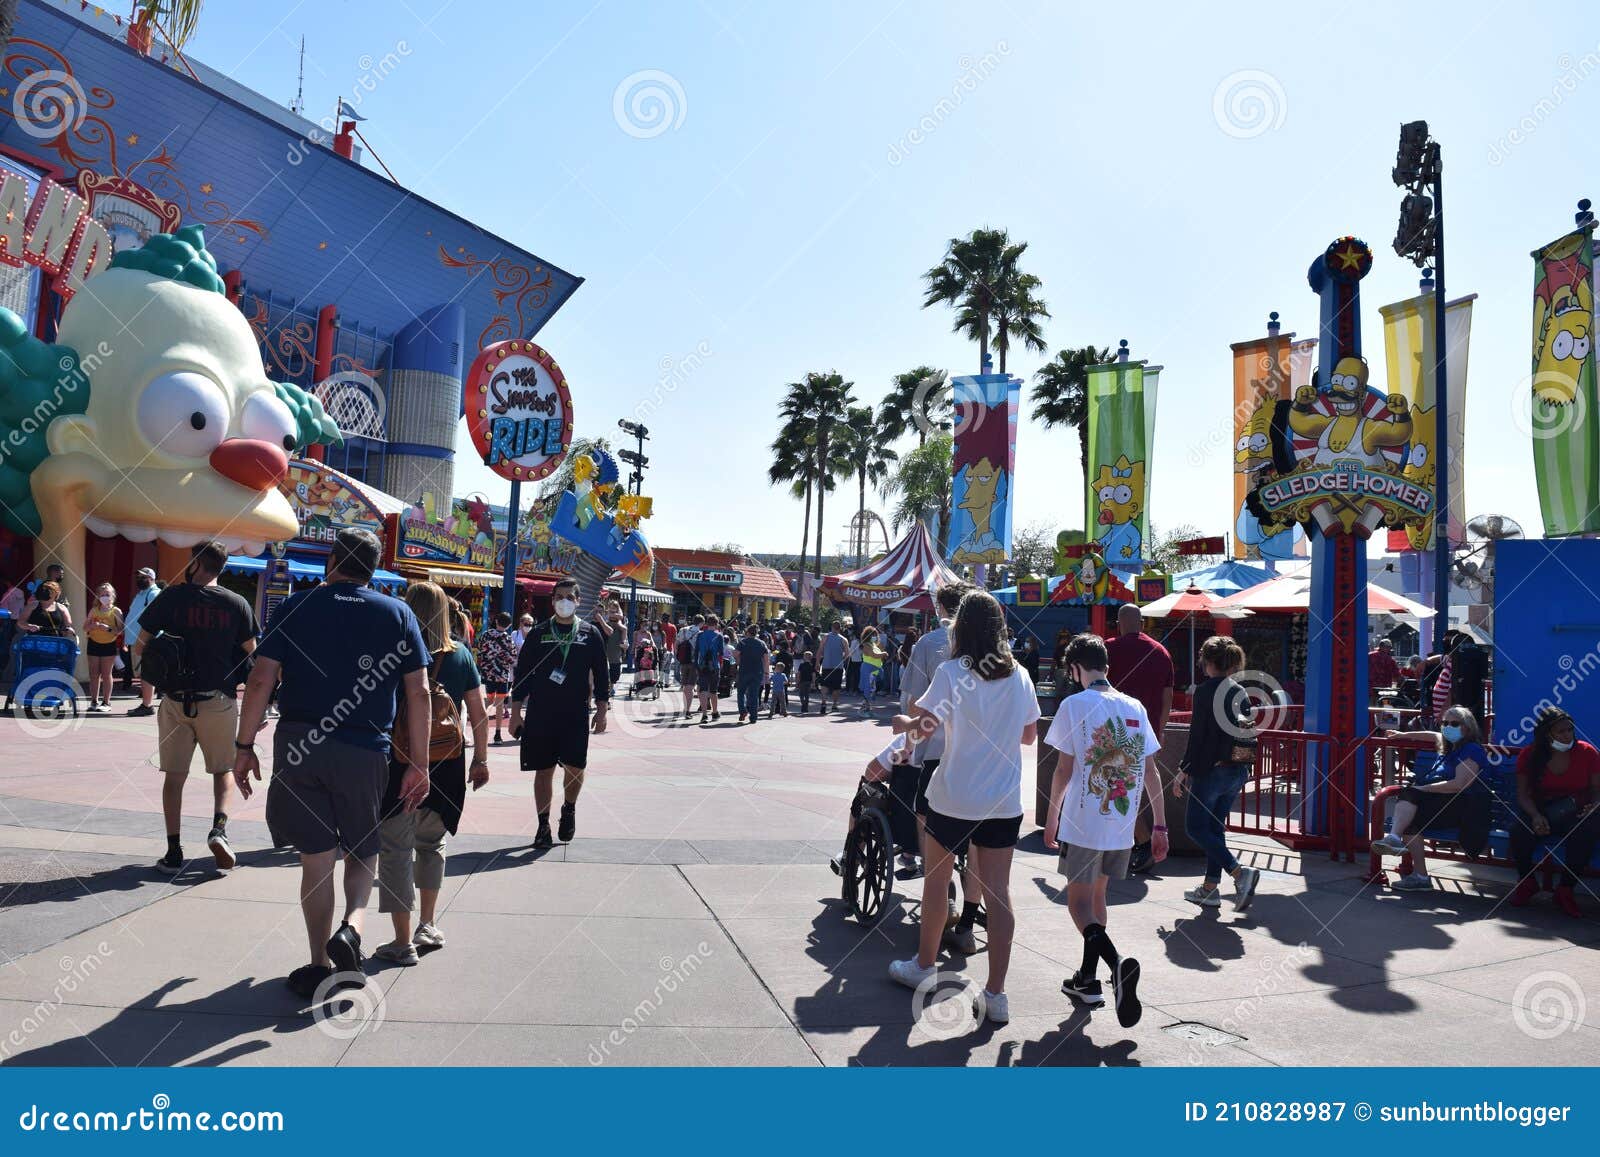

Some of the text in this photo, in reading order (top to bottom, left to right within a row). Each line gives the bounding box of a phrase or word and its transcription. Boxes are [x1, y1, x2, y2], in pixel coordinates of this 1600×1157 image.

[487, 416, 562, 465] RIDE
[1337, 463, 1358, 472] THE
[1264, 473, 1431, 512] SLEDGE HOMER
[846, 587, 904, 600] HOT DOGS!
